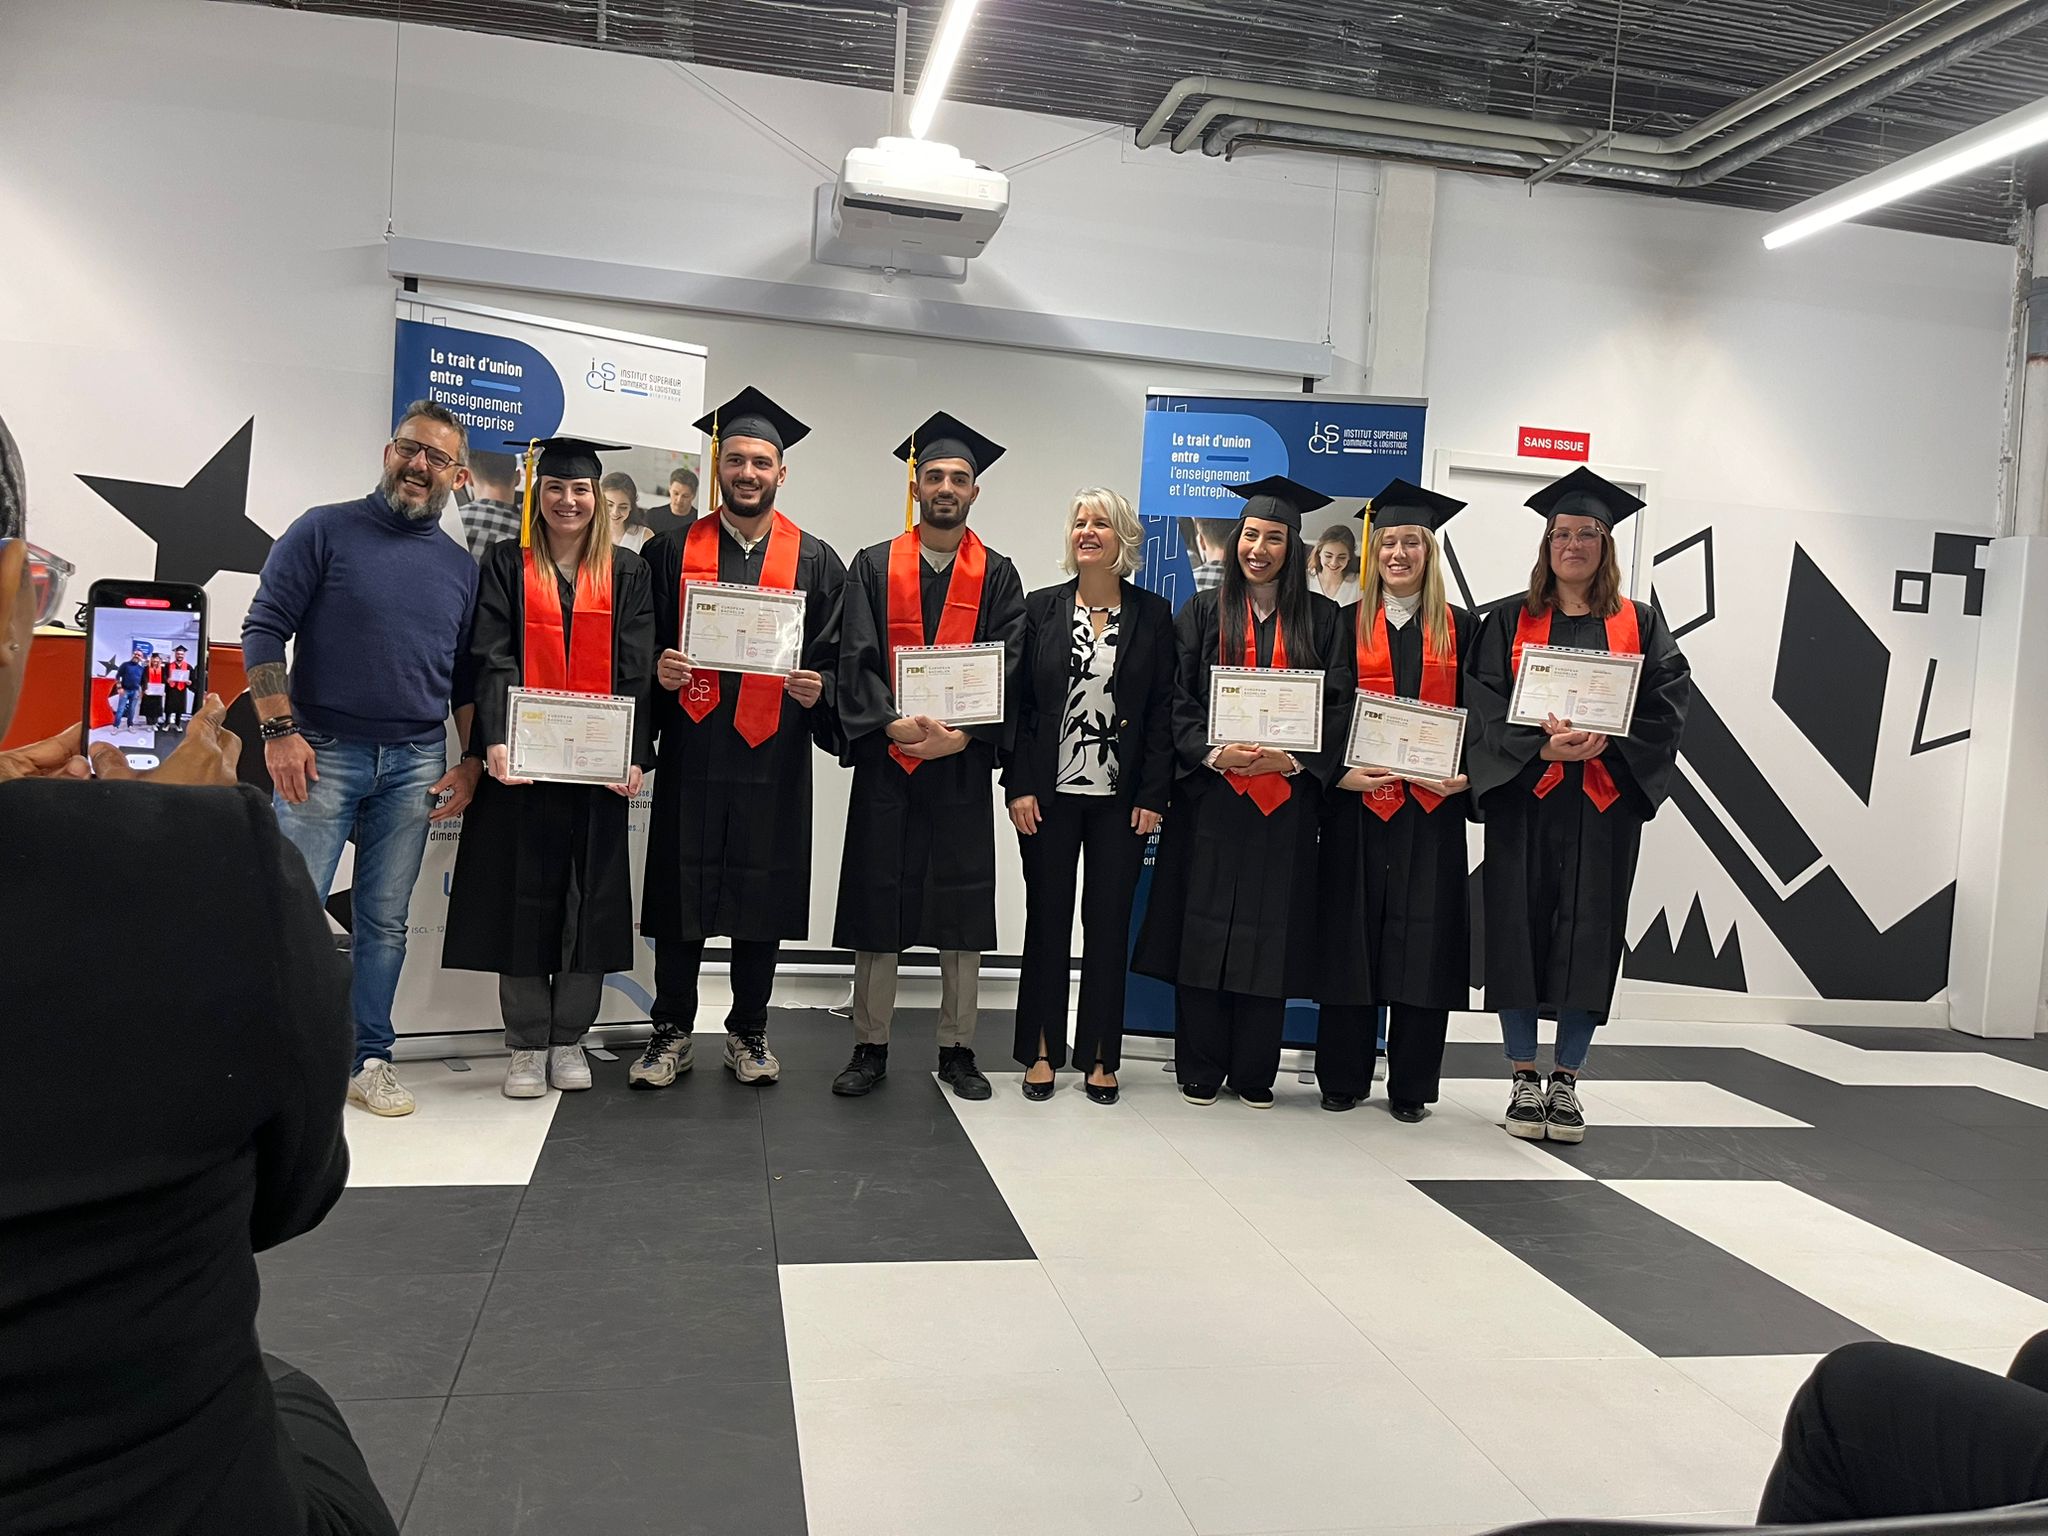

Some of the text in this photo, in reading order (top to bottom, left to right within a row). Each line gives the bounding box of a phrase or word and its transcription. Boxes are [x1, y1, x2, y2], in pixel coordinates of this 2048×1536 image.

[430, 348, 523, 378] Le trait d'union
[429, 370, 464, 387] entre
[620, 369, 682, 388] INSTITUT SUPERIEUR
[619, 379, 648, 391] COMMERCE
[654, 385, 681, 396] LOGISTIQUE
[429, 386, 523, 415] l'enseignement
[1172, 432, 1251, 448] Le trait d'union
[1343, 429, 1408, 441] INSTITUT SUPERIEUR
[1342, 438, 1408, 450] COMMERCE & LOGISTIQUE
[1523, 436, 1584, 452] SANS ISSUE
[1171, 450, 1200, 463] entre
[1170, 466, 1251, 482] l'enseignement
[1169, 484, 1181, 496] et
[696, 602, 717, 612] FEDE
[906, 666, 925, 674] FEDE
[1530, 664, 1551, 673] FEDE
[1221, 686, 1240, 694] FEDE
[1364, 710, 1383, 720] FEDE
